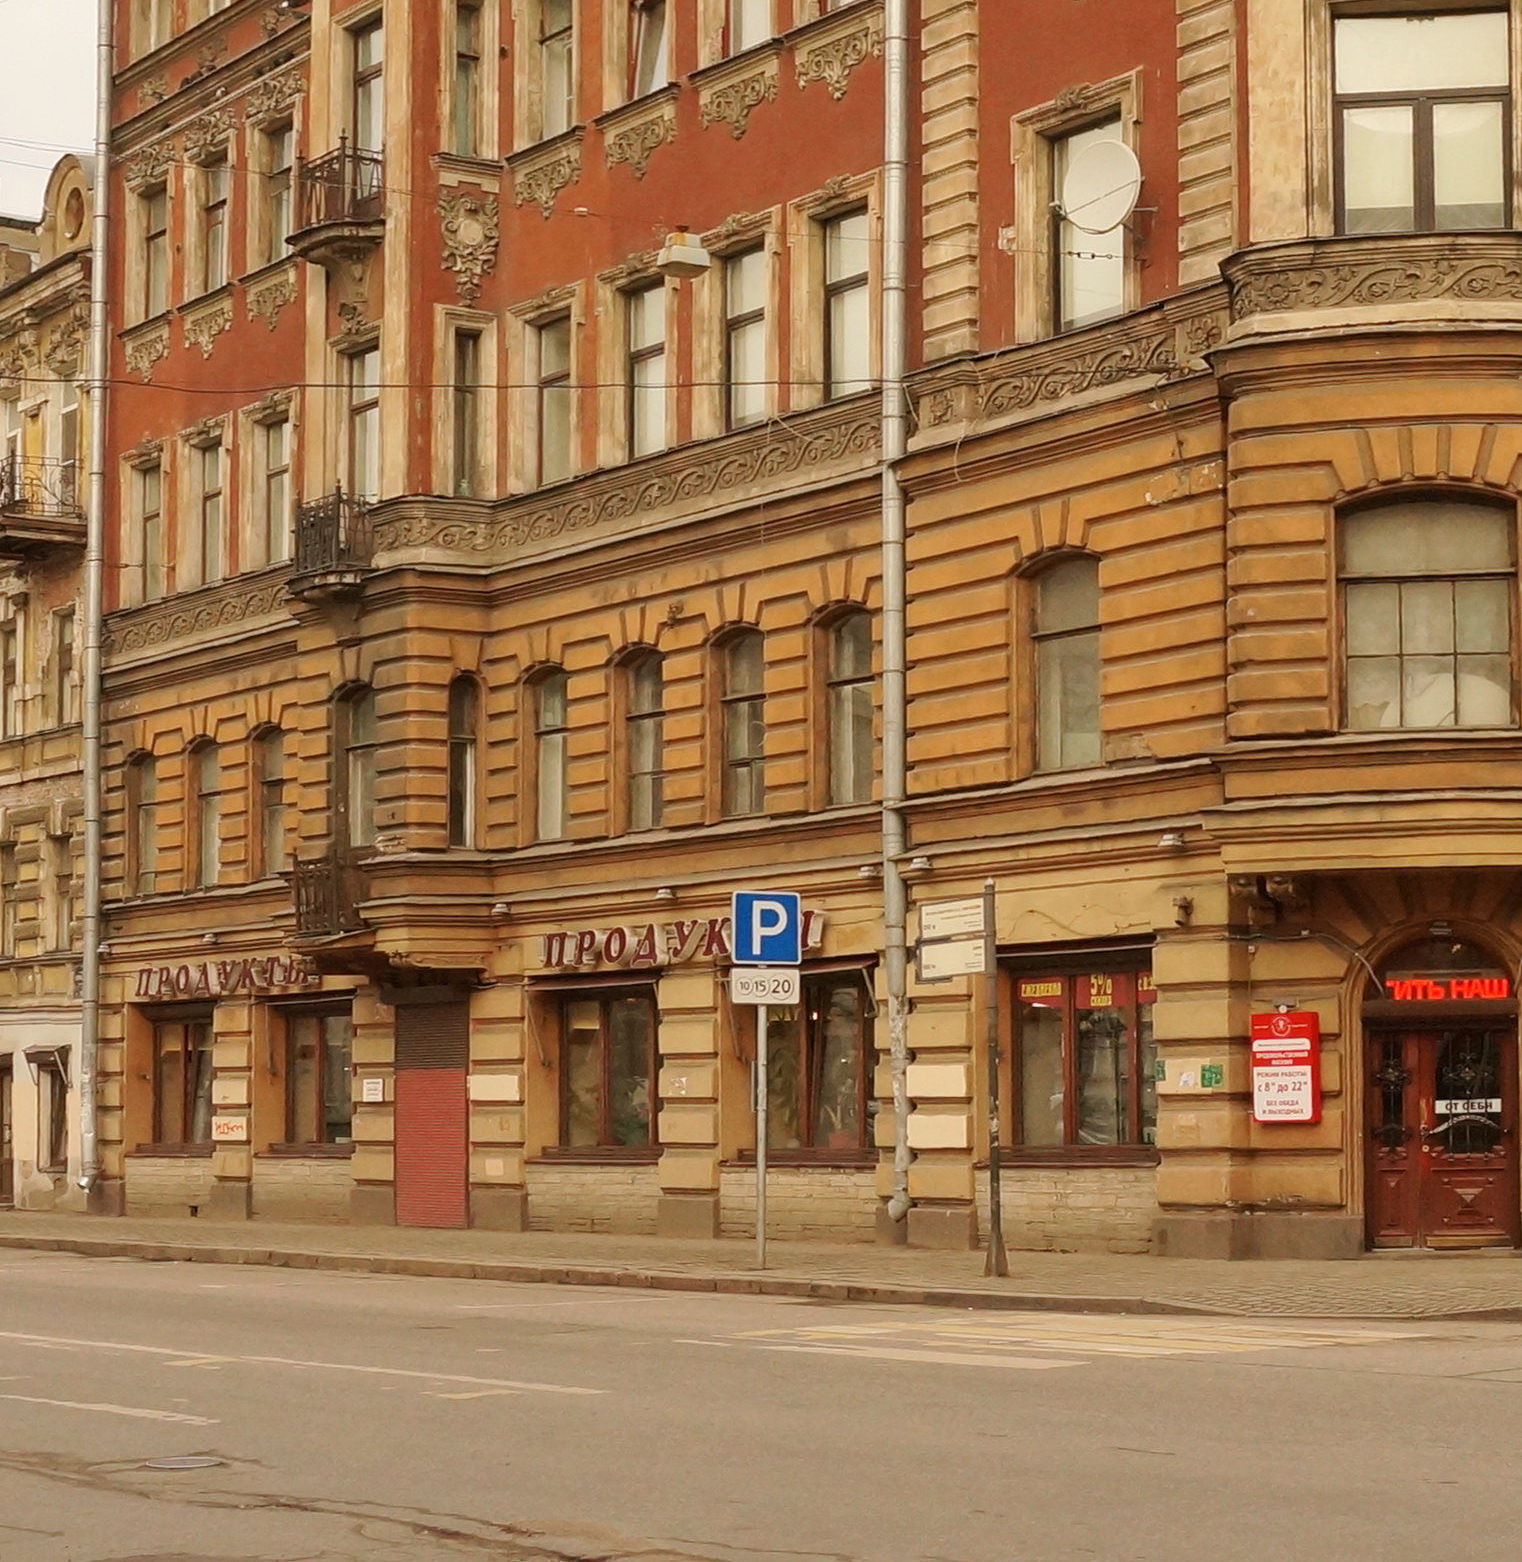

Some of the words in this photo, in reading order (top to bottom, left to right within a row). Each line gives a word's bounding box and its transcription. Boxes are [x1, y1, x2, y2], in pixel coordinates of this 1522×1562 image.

[752, 900, 788, 955] P
[543, 910, 816, 969] ПРОДУК
[739, 981, 751, 992] 10
[754, 980, 768, 993] 15
[771, 979, 792, 993] 20
[1450, 978, 1509, 999] НАШ
[1277, 1083, 1289, 1093] до
[1445, 1103, 1459, 1111] ОТ
